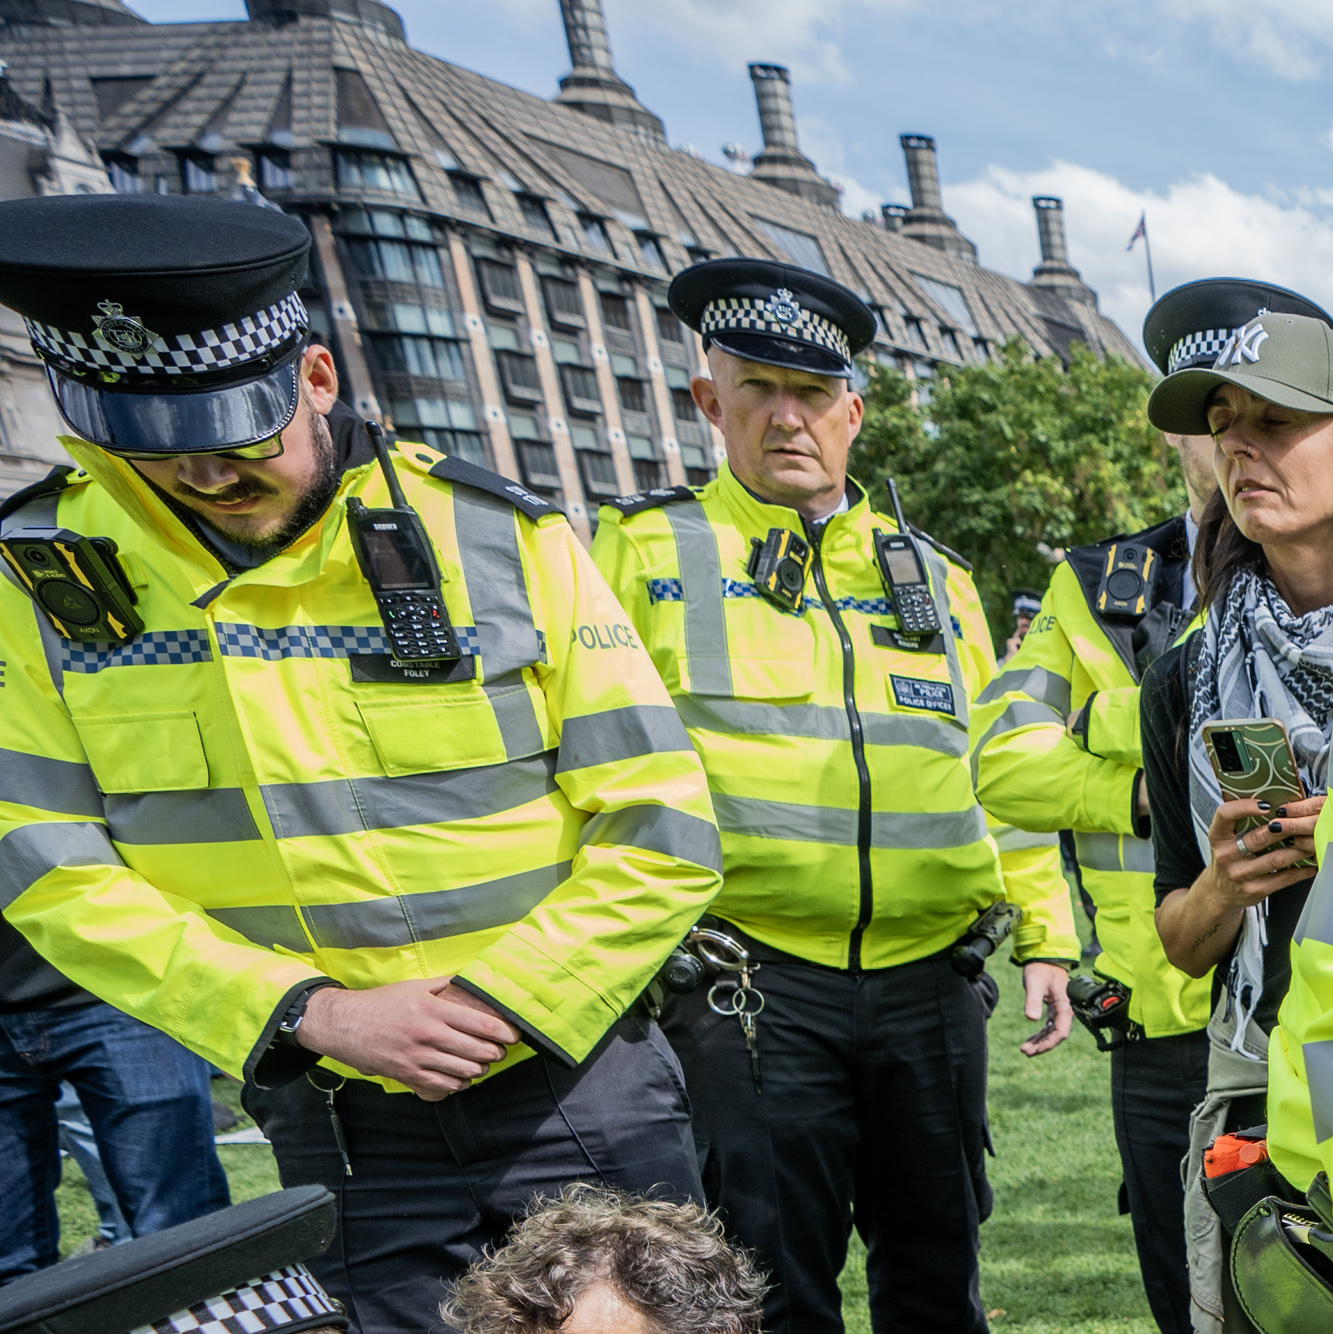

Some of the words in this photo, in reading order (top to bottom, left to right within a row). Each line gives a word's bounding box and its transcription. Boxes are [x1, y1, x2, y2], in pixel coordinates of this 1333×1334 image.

[1028, 616, 1057, 635] LICE
[390, 660, 441, 669] CONSTABLE
[404, 669, 430, 678] FOLEY
[899, 695, 926, 706] POLICE
